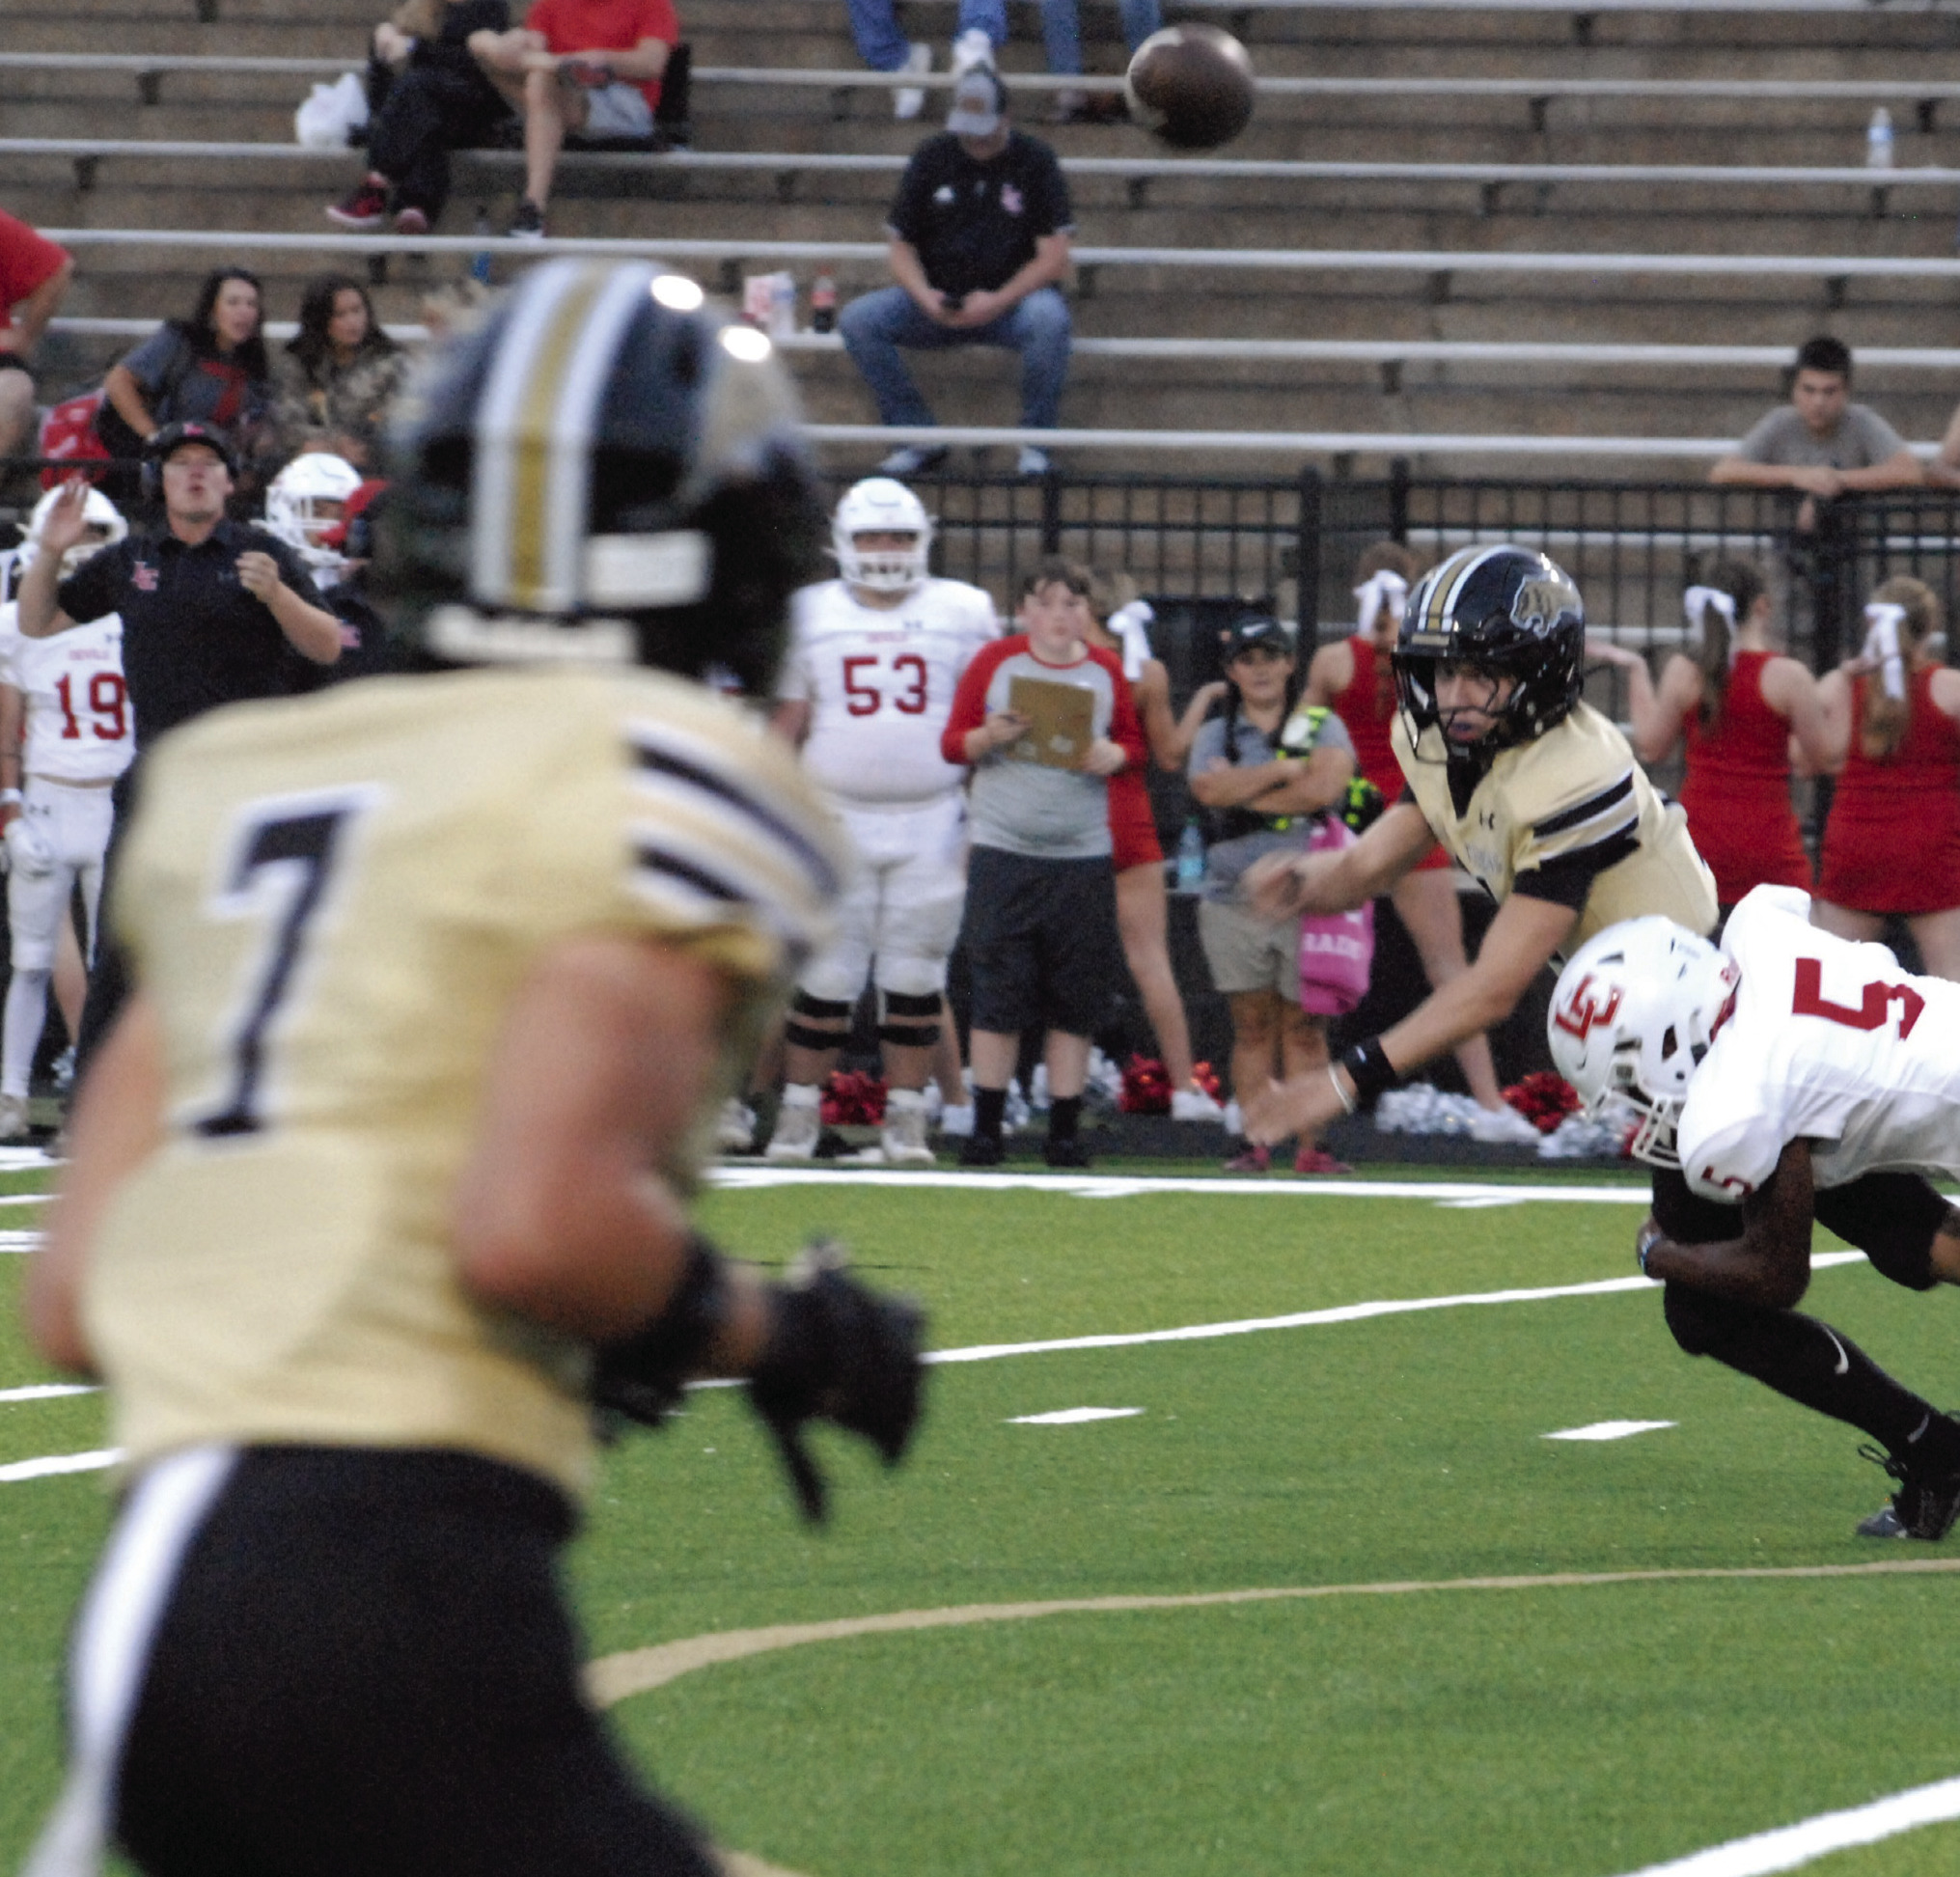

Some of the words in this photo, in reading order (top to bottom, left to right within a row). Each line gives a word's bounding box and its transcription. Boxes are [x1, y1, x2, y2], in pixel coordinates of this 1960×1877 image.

[54, 672, 126, 740] 19
[842, 653, 927, 716] 53
[188, 787, 381, 1141] 7
[1792, 957, 1925, 1040] 5
[1701, 1166, 1753, 1196] 5
